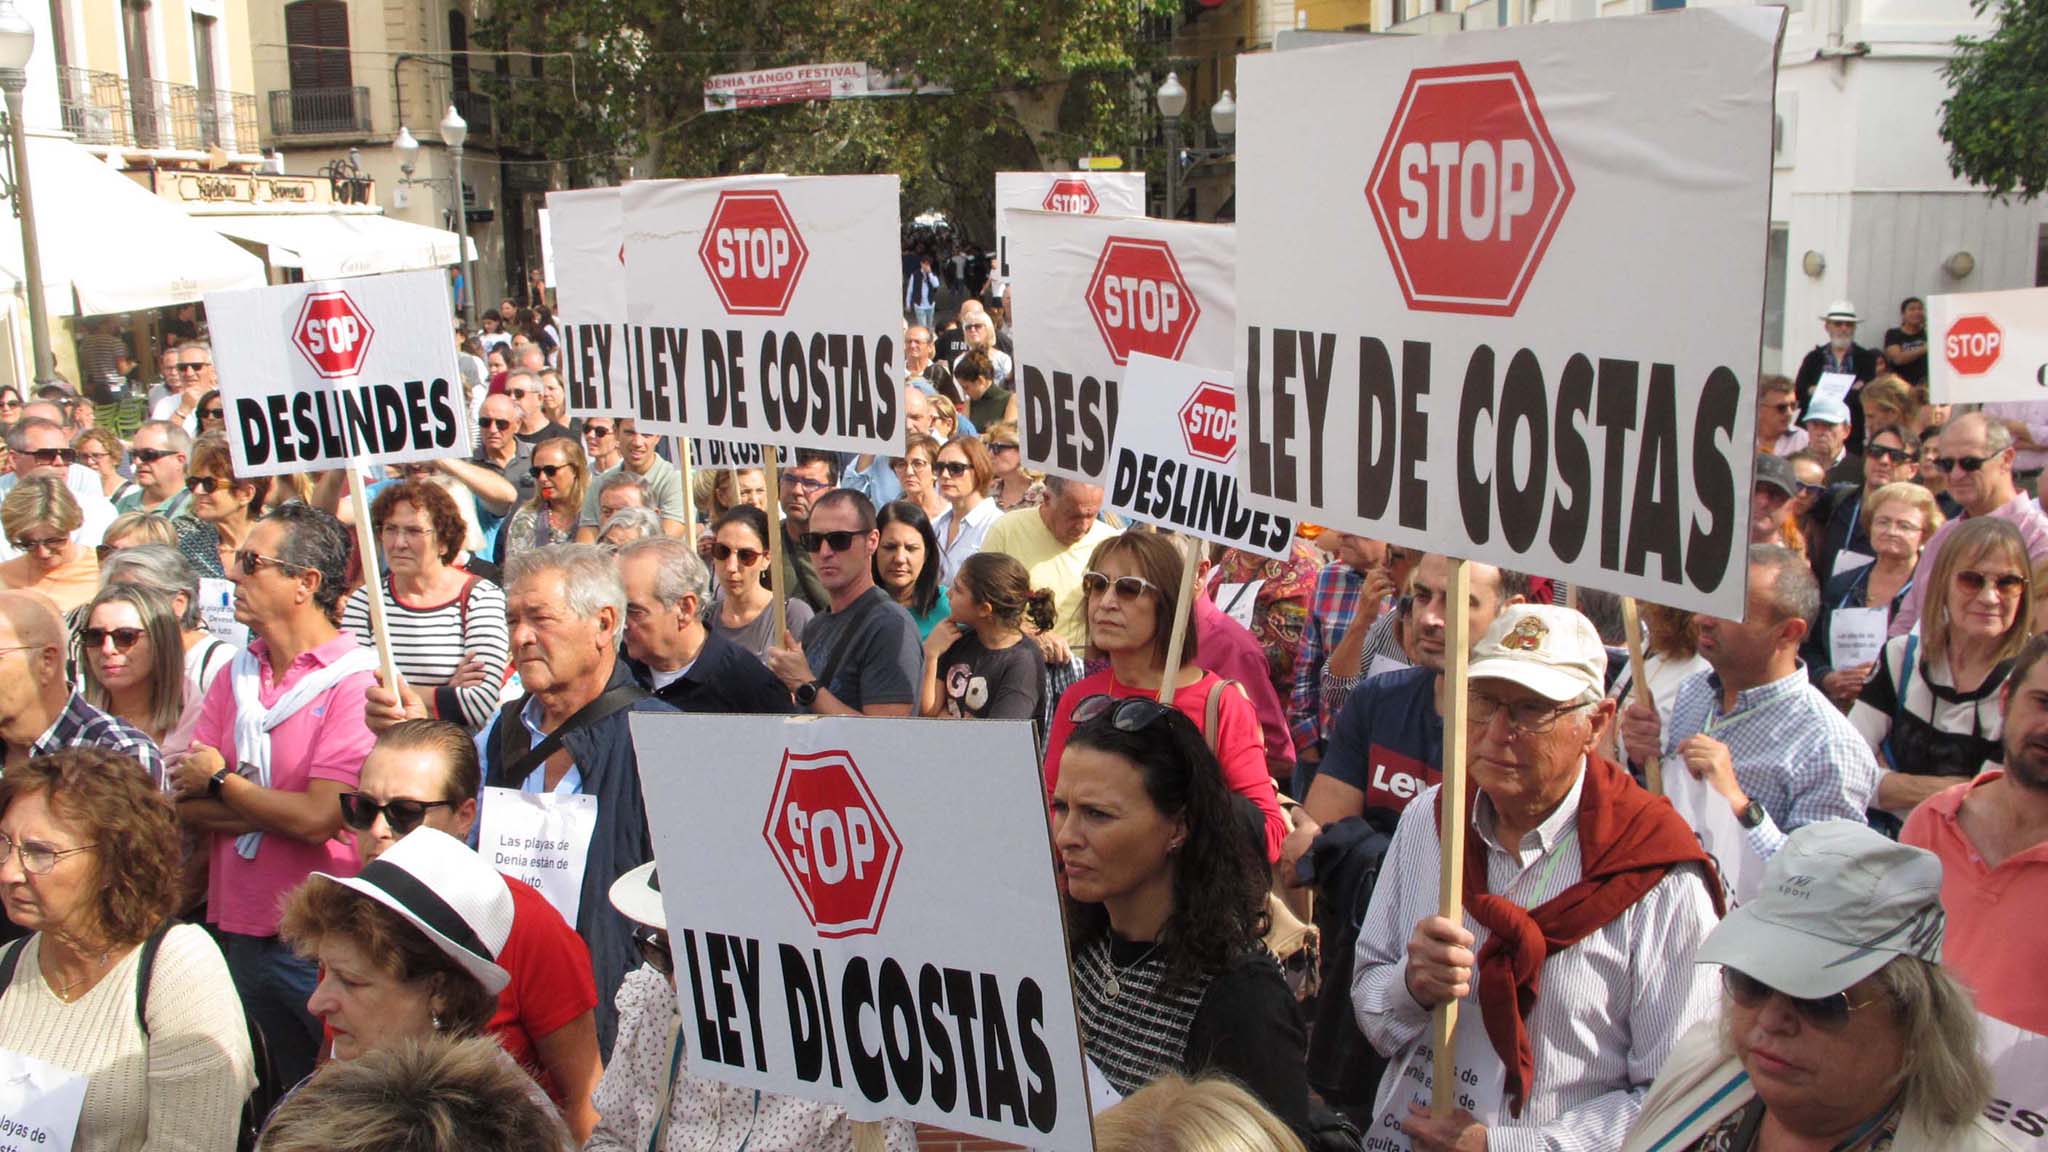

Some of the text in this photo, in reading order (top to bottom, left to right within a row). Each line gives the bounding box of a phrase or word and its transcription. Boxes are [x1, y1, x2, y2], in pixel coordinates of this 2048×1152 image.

[750, 70, 793, 85] TANGO
[798, 66, 859, 79] FESTIVAL
[1052, 193, 1090, 214] STOP
[1399, 138, 1536, 242] STOP
[716, 227, 790, 280] STOP
[1103, 274, 1180, 334] STOP
[565, 323, 612, 409] LEY
[1946, 332, 2001, 359] STOP
[634, 326, 689, 424] LEY
[702, 328, 748, 428] DE
[760, 329, 897, 442] COSTAS
[235, 377, 457, 467] DESLINDES
[1189, 402, 1237, 442] STOP
[1247, 325, 1741, 595] LEY DE COSTAS
[495, 852, 569, 870] Denia están de
[499, 834, 570, 851] Las playas de
[786, 801, 876, 885] SOP
[683, 927, 769, 1072] LEY
[841, 955, 1058, 1134] COSTAS
[1460, 1068, 1479, 1086] de
[1459, 1093, 1476, 1111] de
[0, 1114, 46, 1144] layas de
